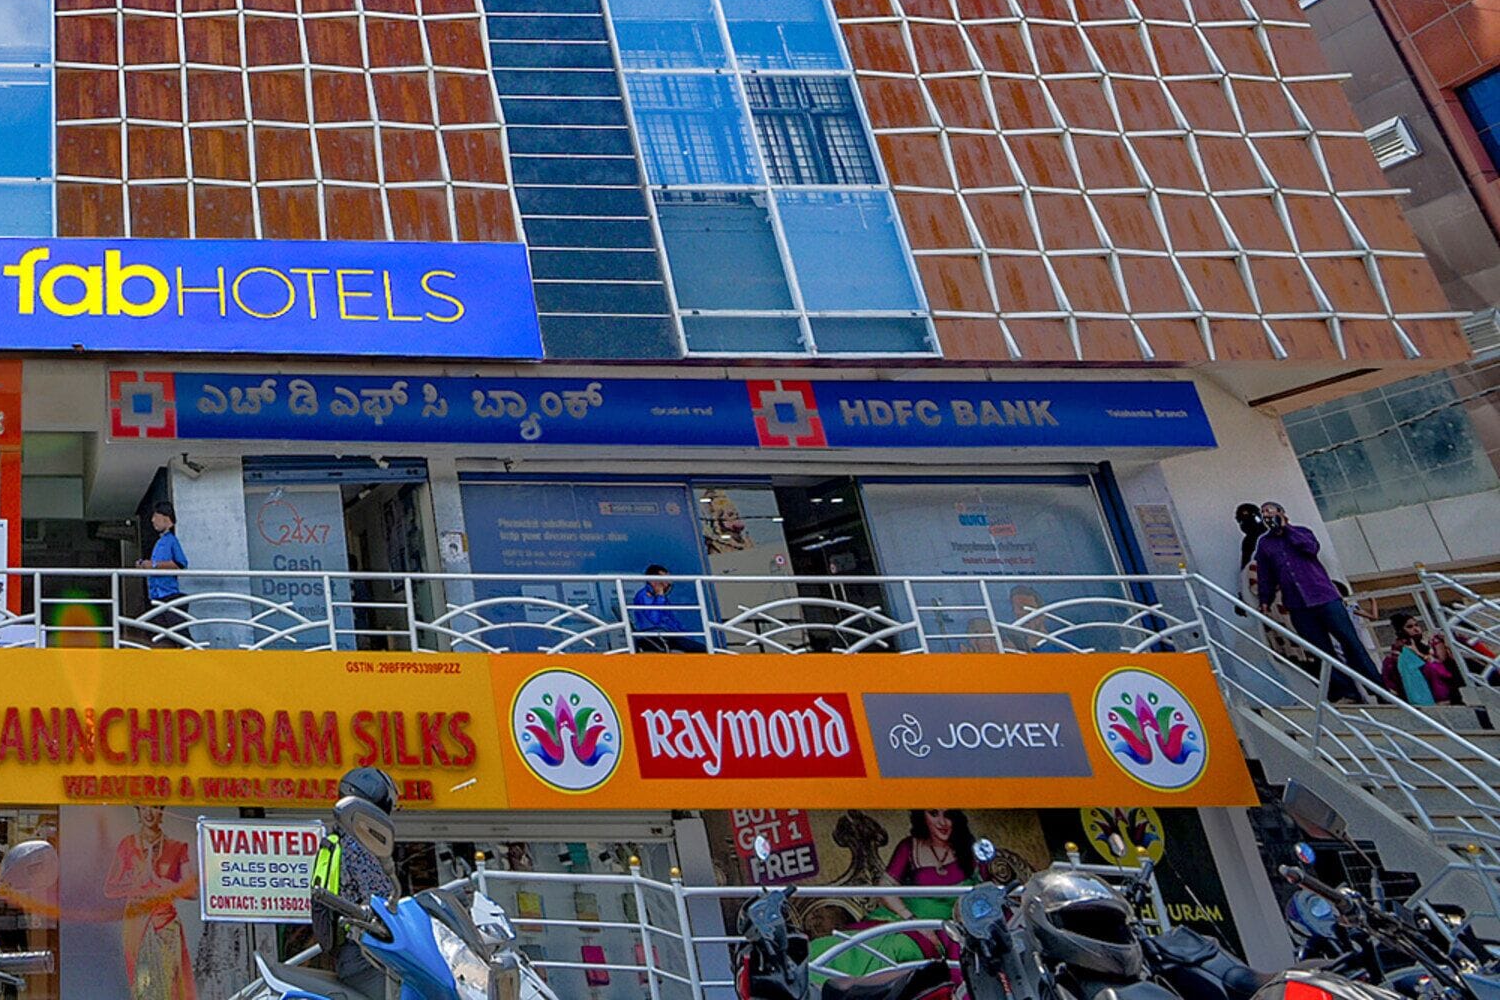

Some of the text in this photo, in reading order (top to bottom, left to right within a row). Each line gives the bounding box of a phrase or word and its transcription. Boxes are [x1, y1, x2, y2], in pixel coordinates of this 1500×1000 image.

[839, 398, 1060, 427] HDFC BANK
[273, 554, 322, 571] Cash
[261, 579, 337, 601] Depost
[352, 710, 478, 767] SILKS
[639, 696, 851, 776] Raymond
[937, 721, 1064, 751] JOCKEY
[62, 774, 172, 800] WEAVERS
[179, 775, 195, 798] &
[209, 829, 318, 856] WANTED
[788, 821, 802, 840] 1
[221, 861, 308, 874] SALES BOYS
[750, 846, 815, 883] FREE
[221, 876, 309, 888] SALES GIRLS
[210, 895, 258, 910] CONTACT:
